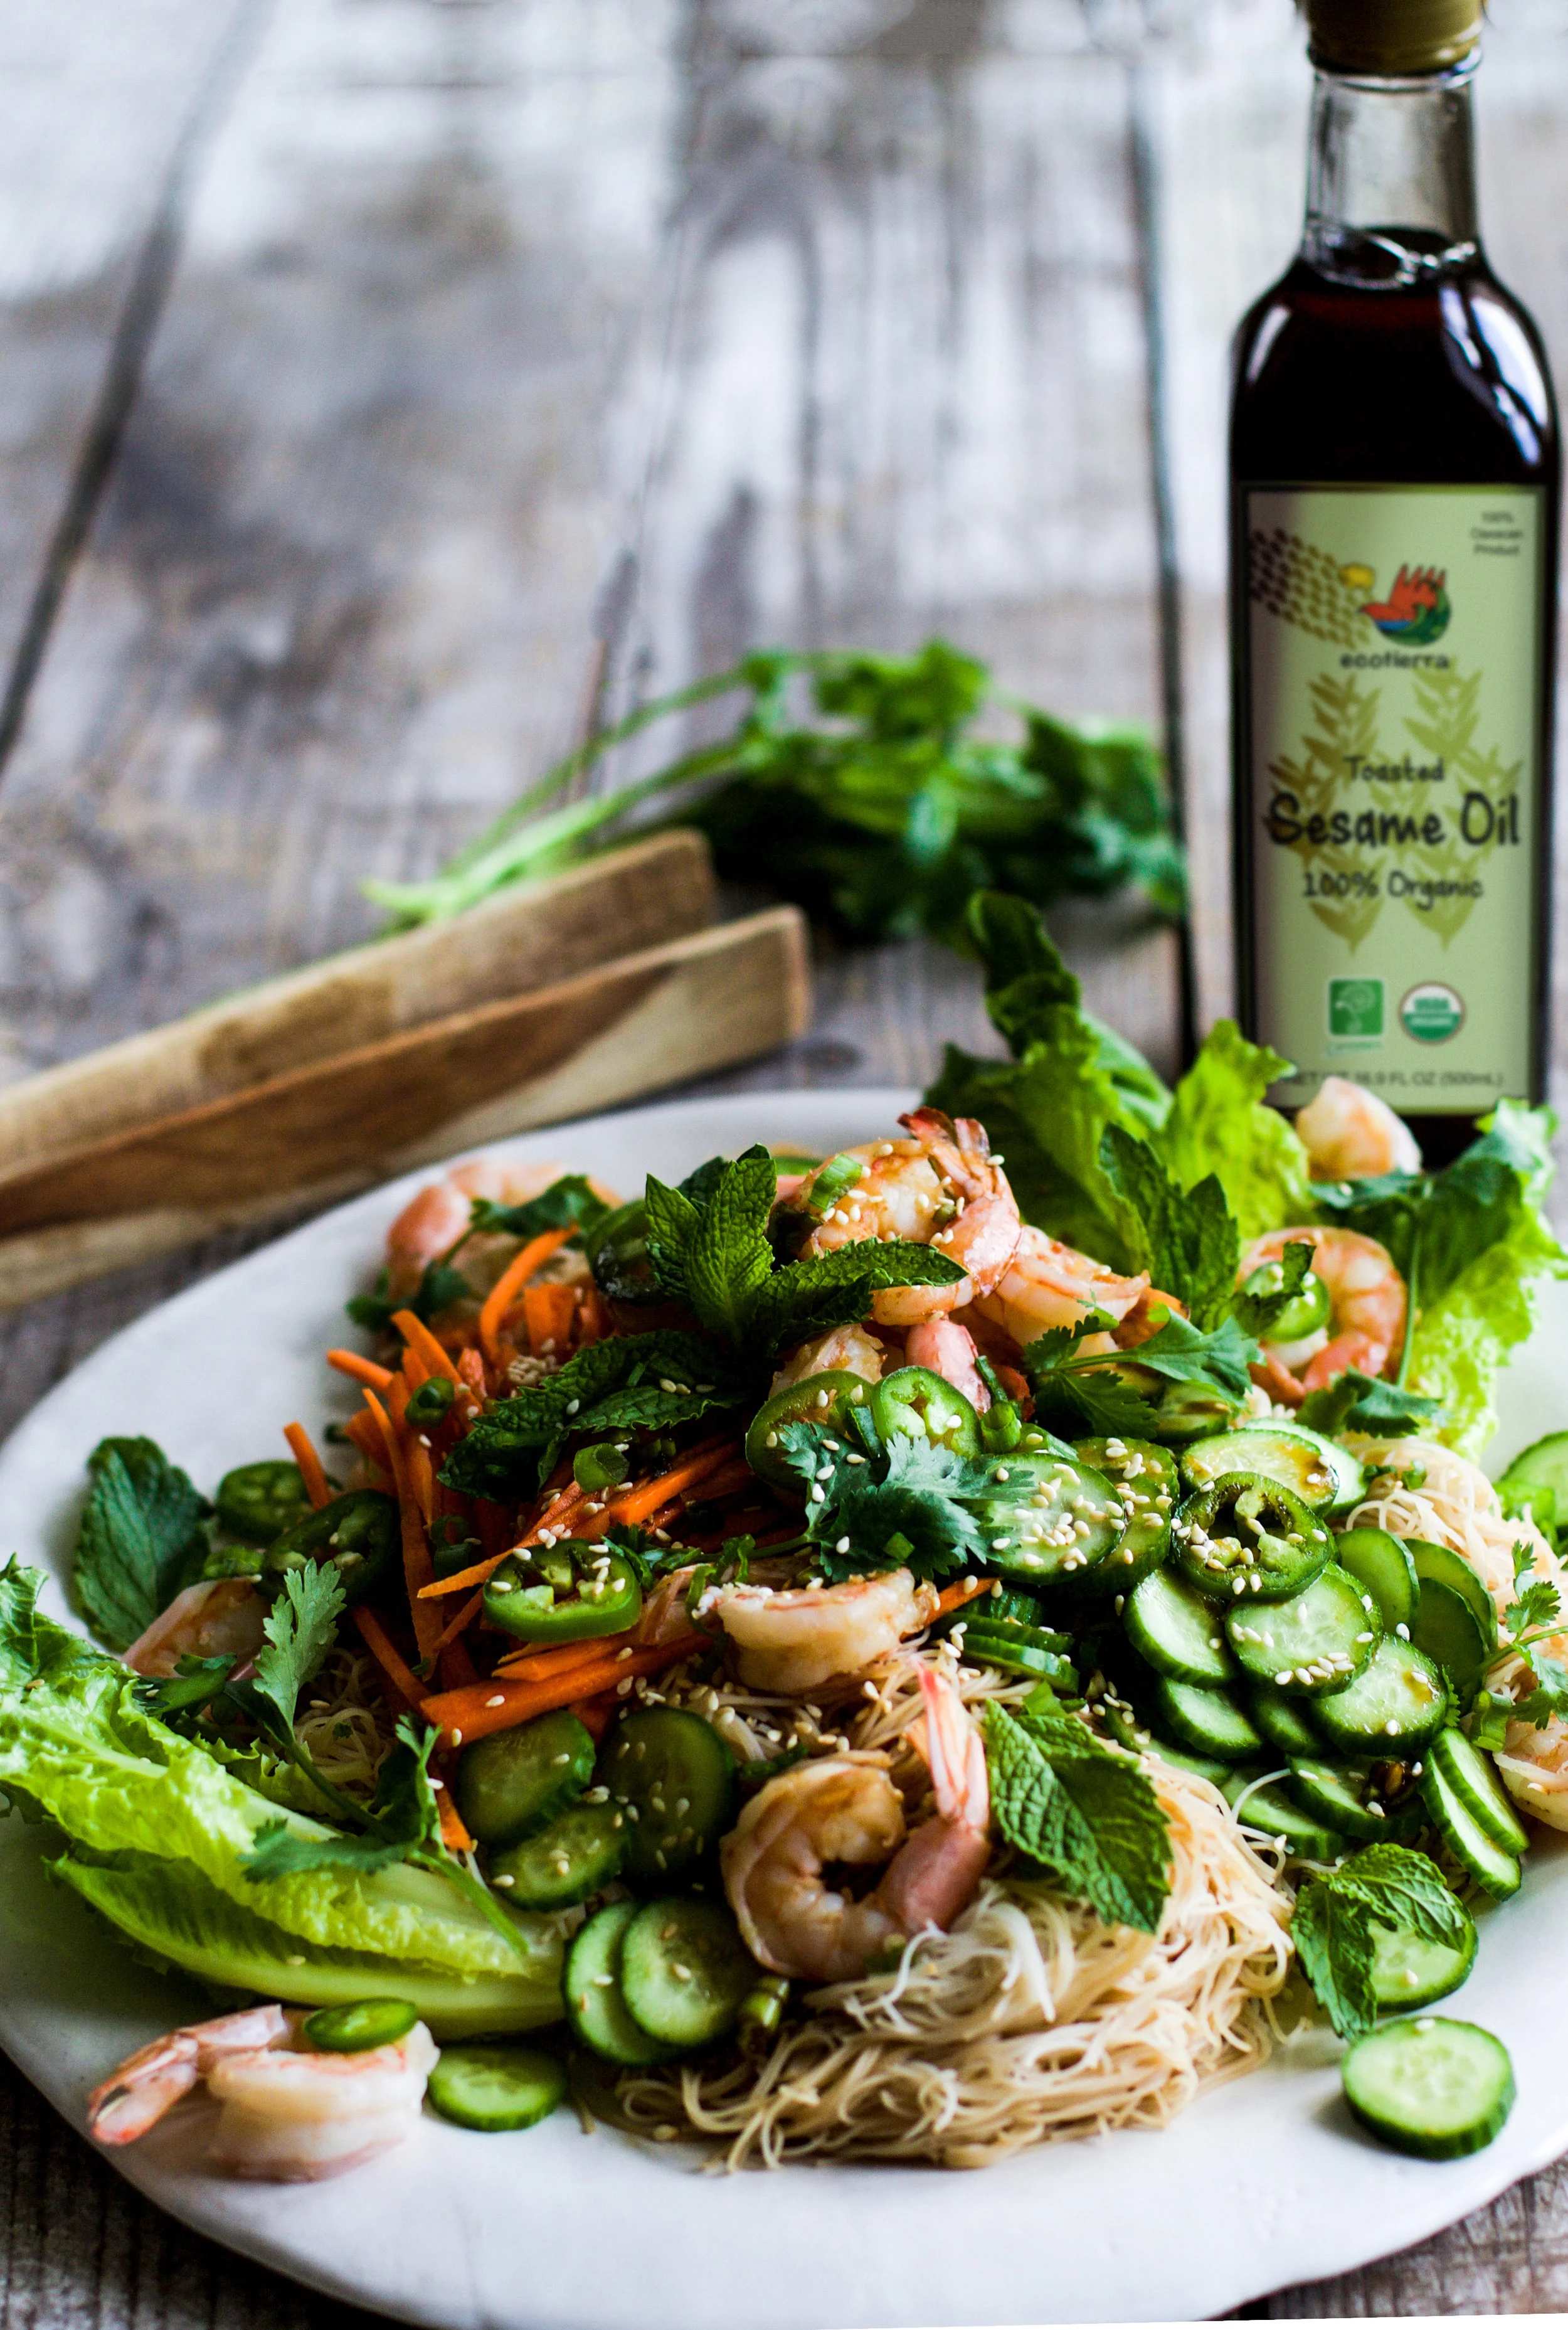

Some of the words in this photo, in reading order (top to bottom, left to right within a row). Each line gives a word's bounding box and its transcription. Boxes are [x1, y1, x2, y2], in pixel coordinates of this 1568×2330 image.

[1340, 650, 1449, 670] ecotierra
[1342, 755, 1446, 782] Toasted
[1268, 792, 1445, 847] Sesame
[1460, 791, 1520, 846] Oil
[1303, 870, 1378, 897] 100%
[1388, 870, 1483, 912] Organic
